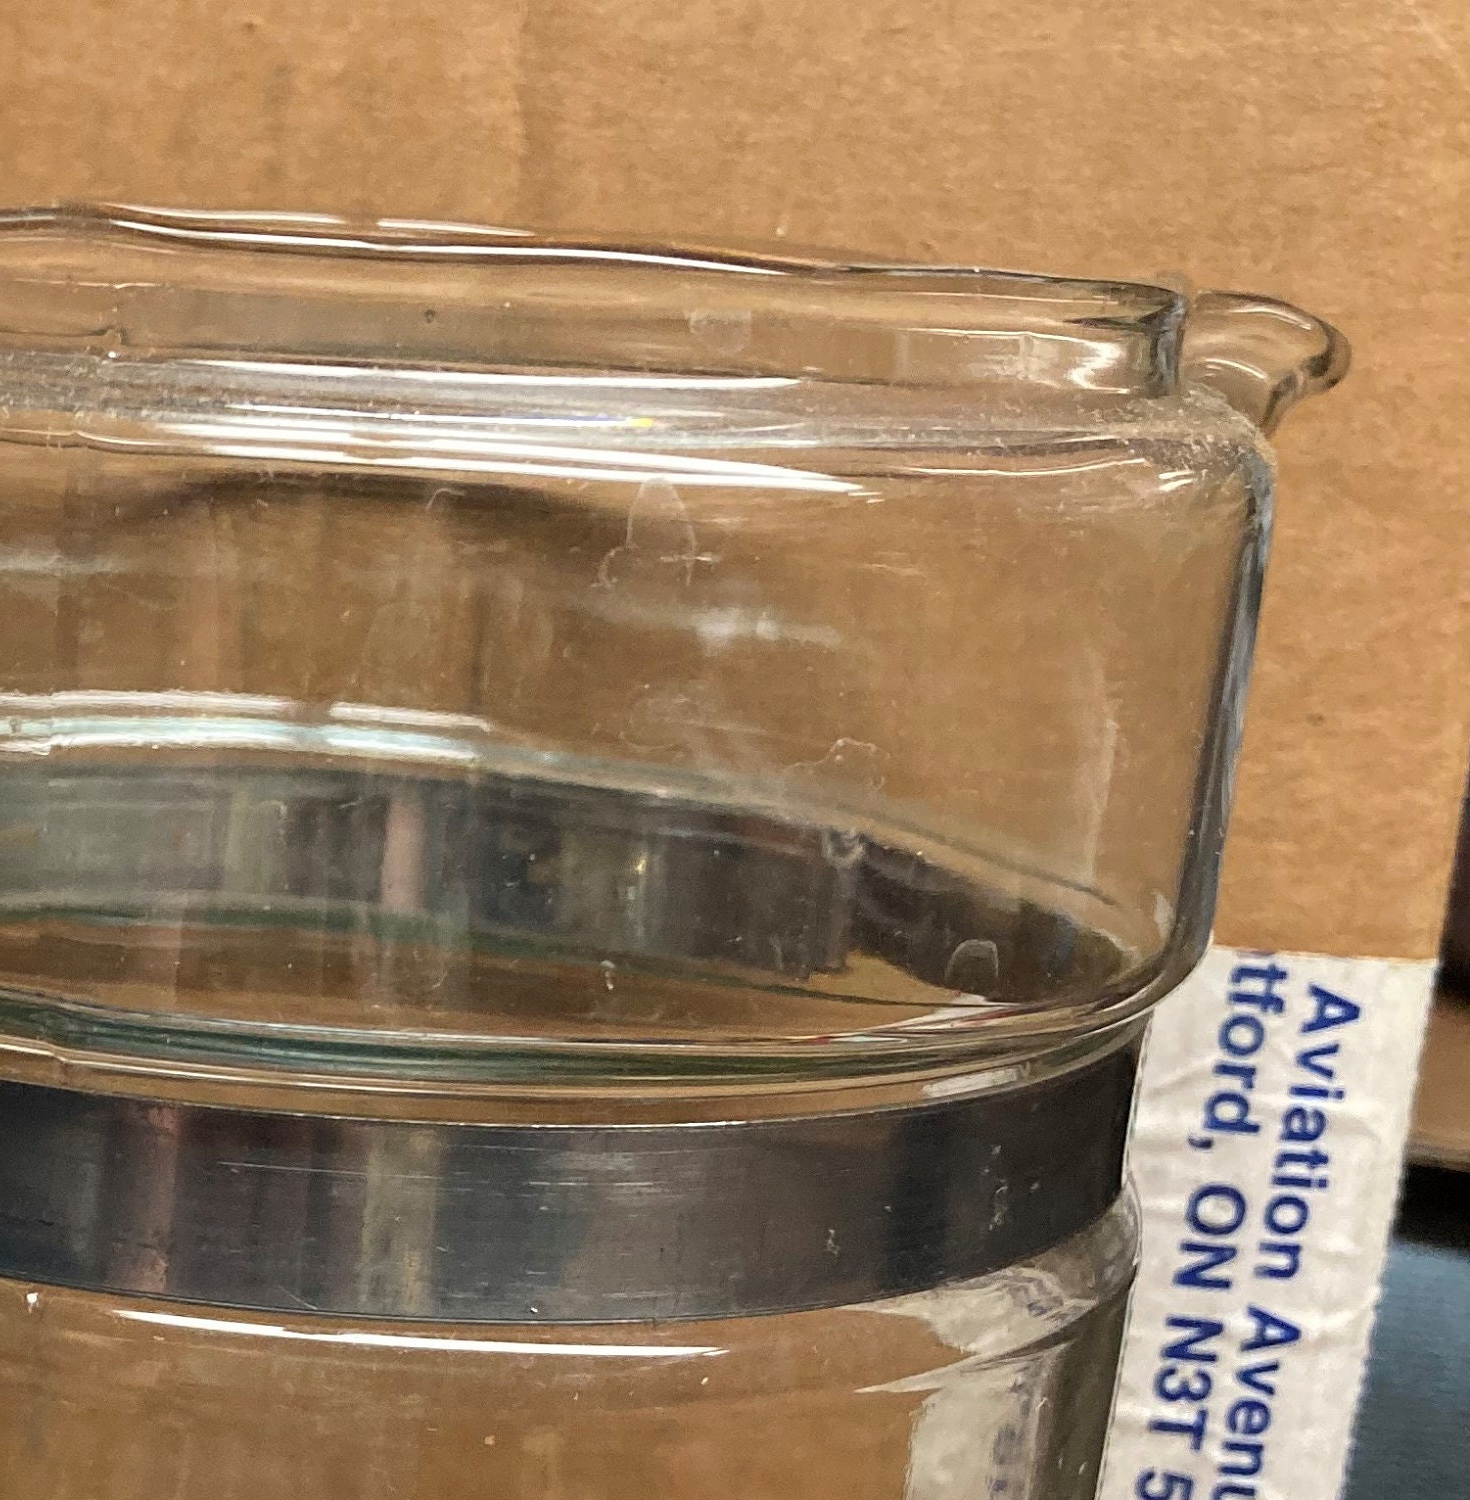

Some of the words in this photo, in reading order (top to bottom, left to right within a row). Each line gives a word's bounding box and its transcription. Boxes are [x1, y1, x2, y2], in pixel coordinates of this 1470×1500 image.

[1187, 952, 1288, 1150] tford,
[1253, 981, 1362, 1280] Aviation
[1172, 1183, 1247, 1291] ON
[1147, 1315, 1225, 1451] N3T
